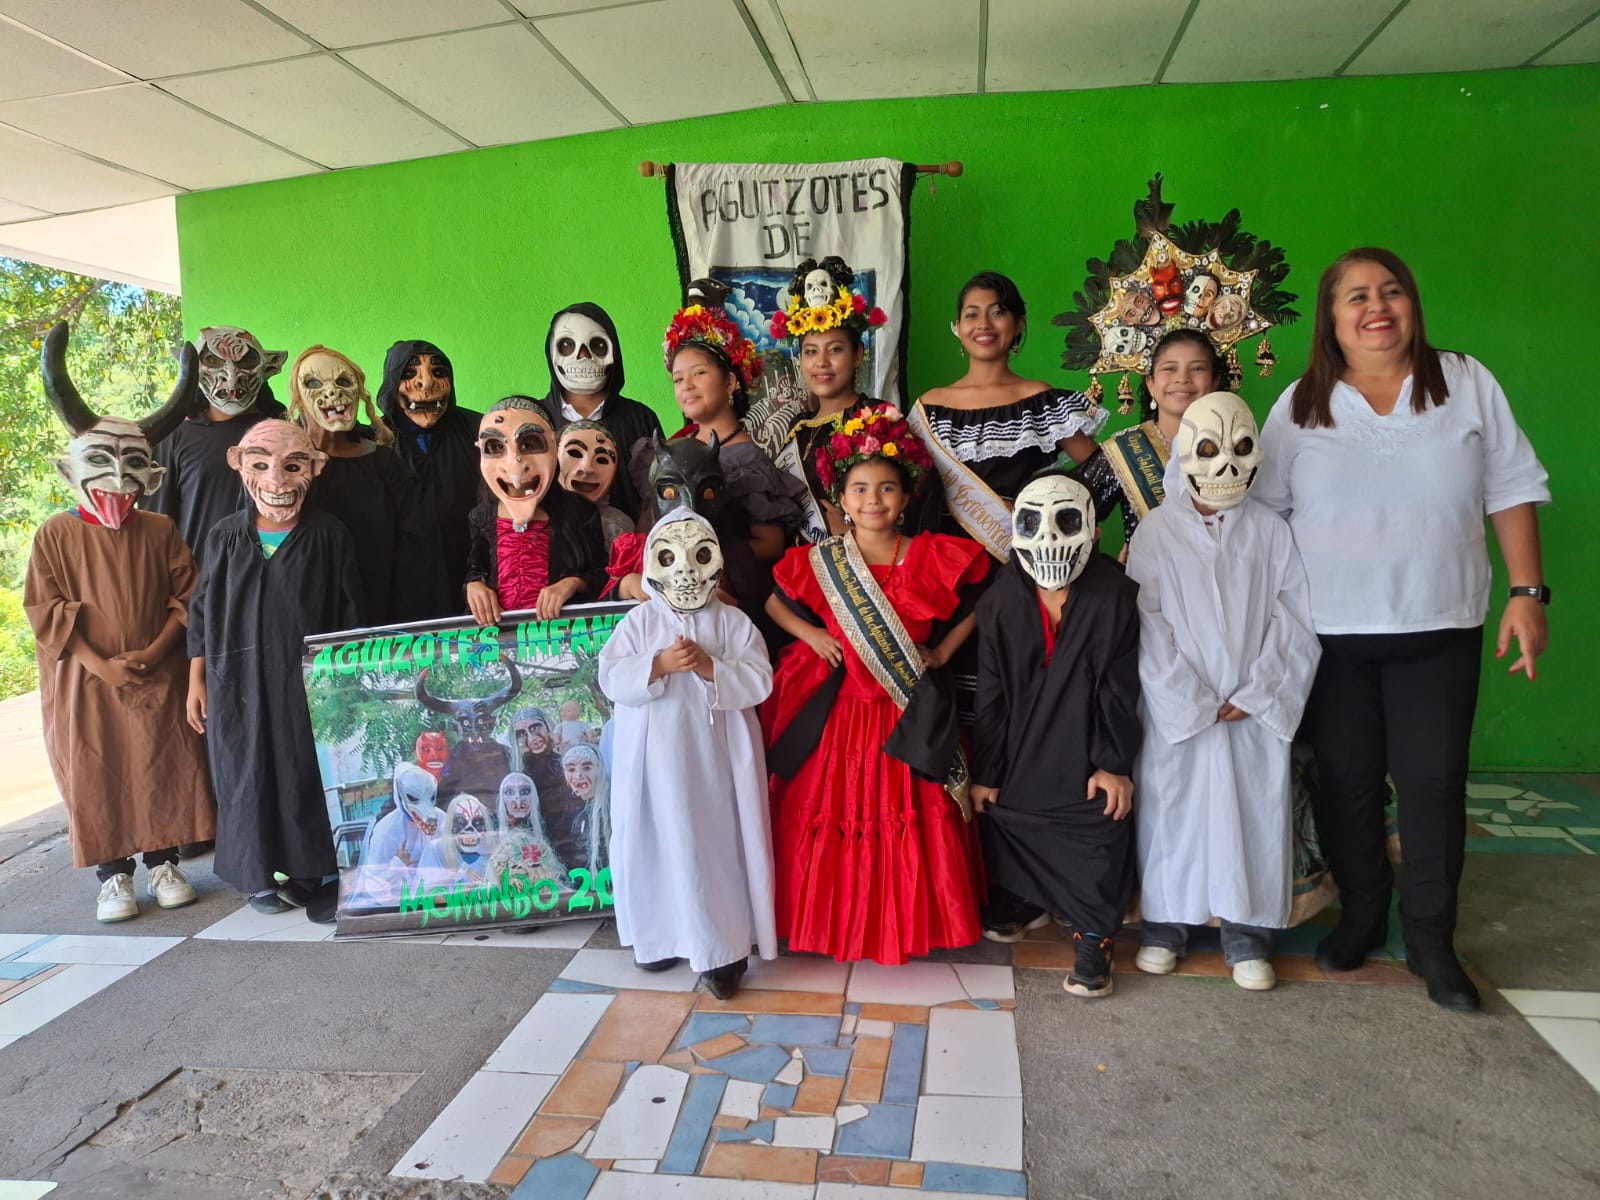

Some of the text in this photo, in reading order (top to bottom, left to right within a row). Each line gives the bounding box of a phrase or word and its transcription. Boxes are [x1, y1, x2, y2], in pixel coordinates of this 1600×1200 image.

[700, 168, 890, 233] AGUIZOTES
[763, 221, 813, 260] DE
[1137, 453, 1162, 487] Infantil
[844, 577, 868, 606] Infantil
